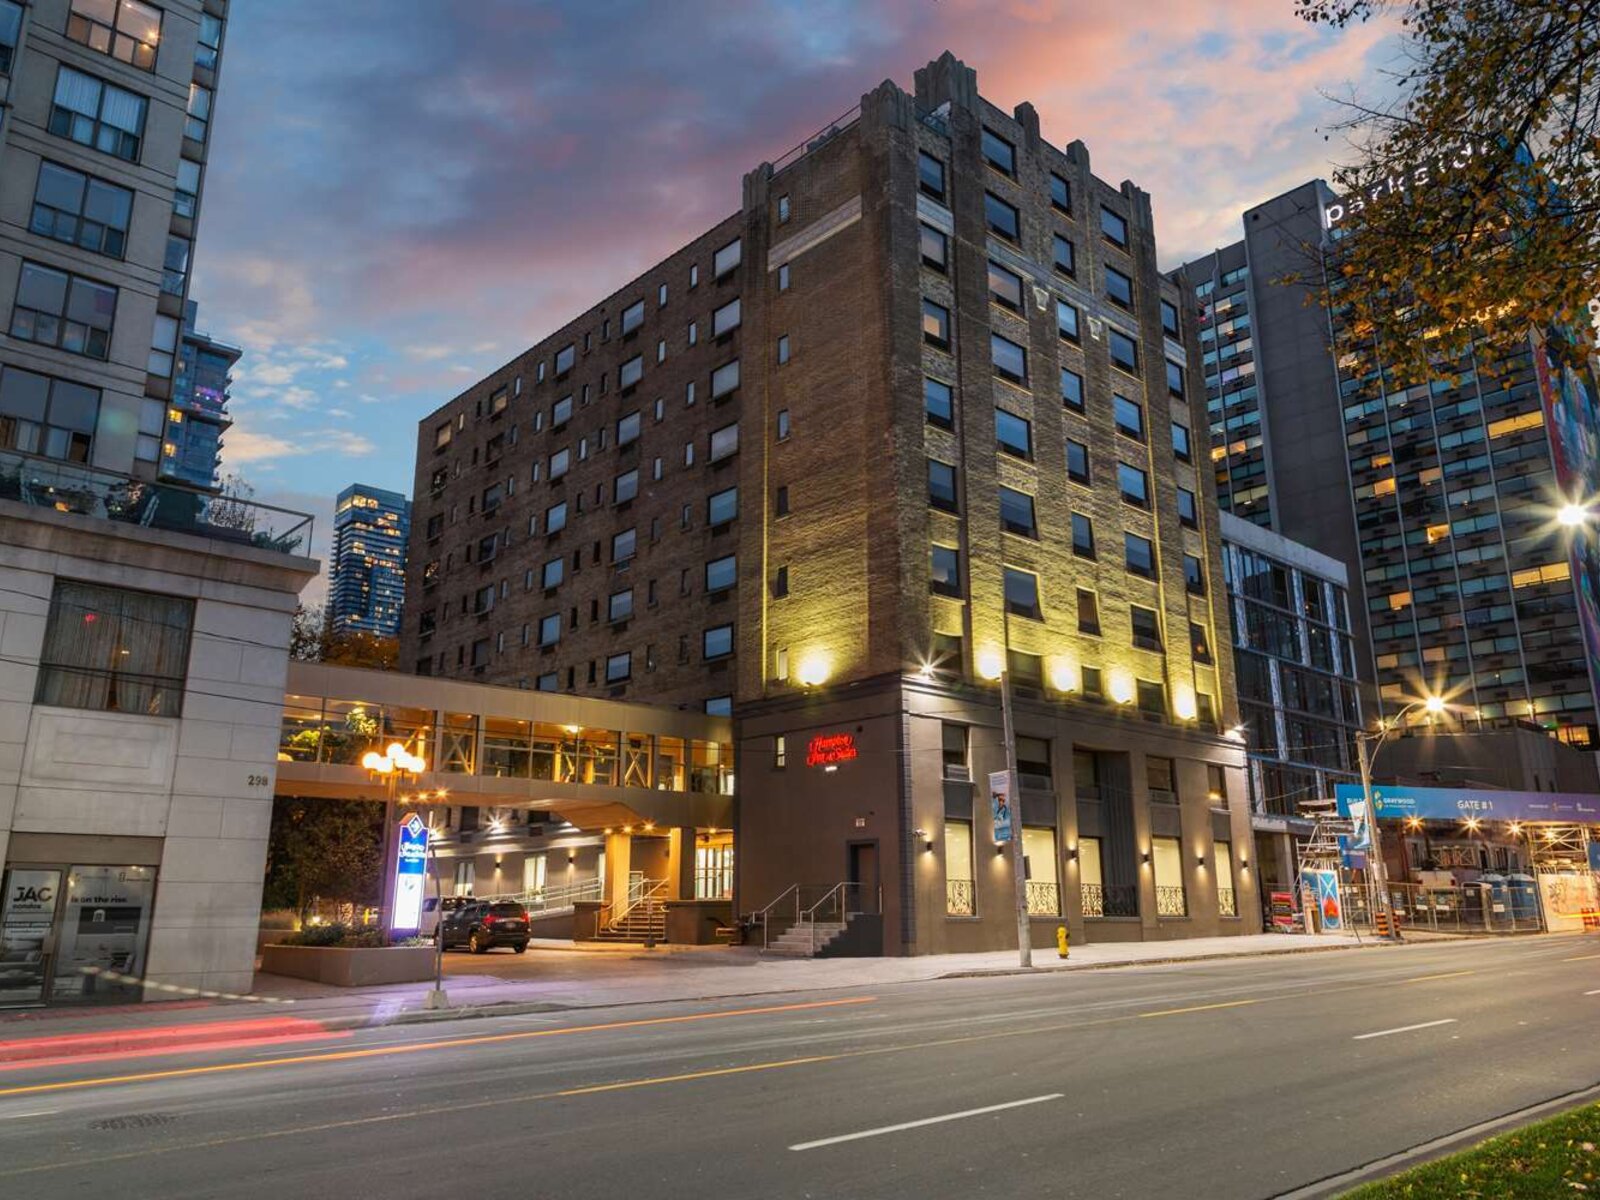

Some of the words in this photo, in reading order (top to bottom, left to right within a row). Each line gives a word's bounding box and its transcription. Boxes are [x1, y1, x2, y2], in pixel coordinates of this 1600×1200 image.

[247, 775, 269, 786] 298
[1456, 799, 1480, 810] GATE
[13, 886, 52, 903] JAC
[94, 894, 109, 903] the
